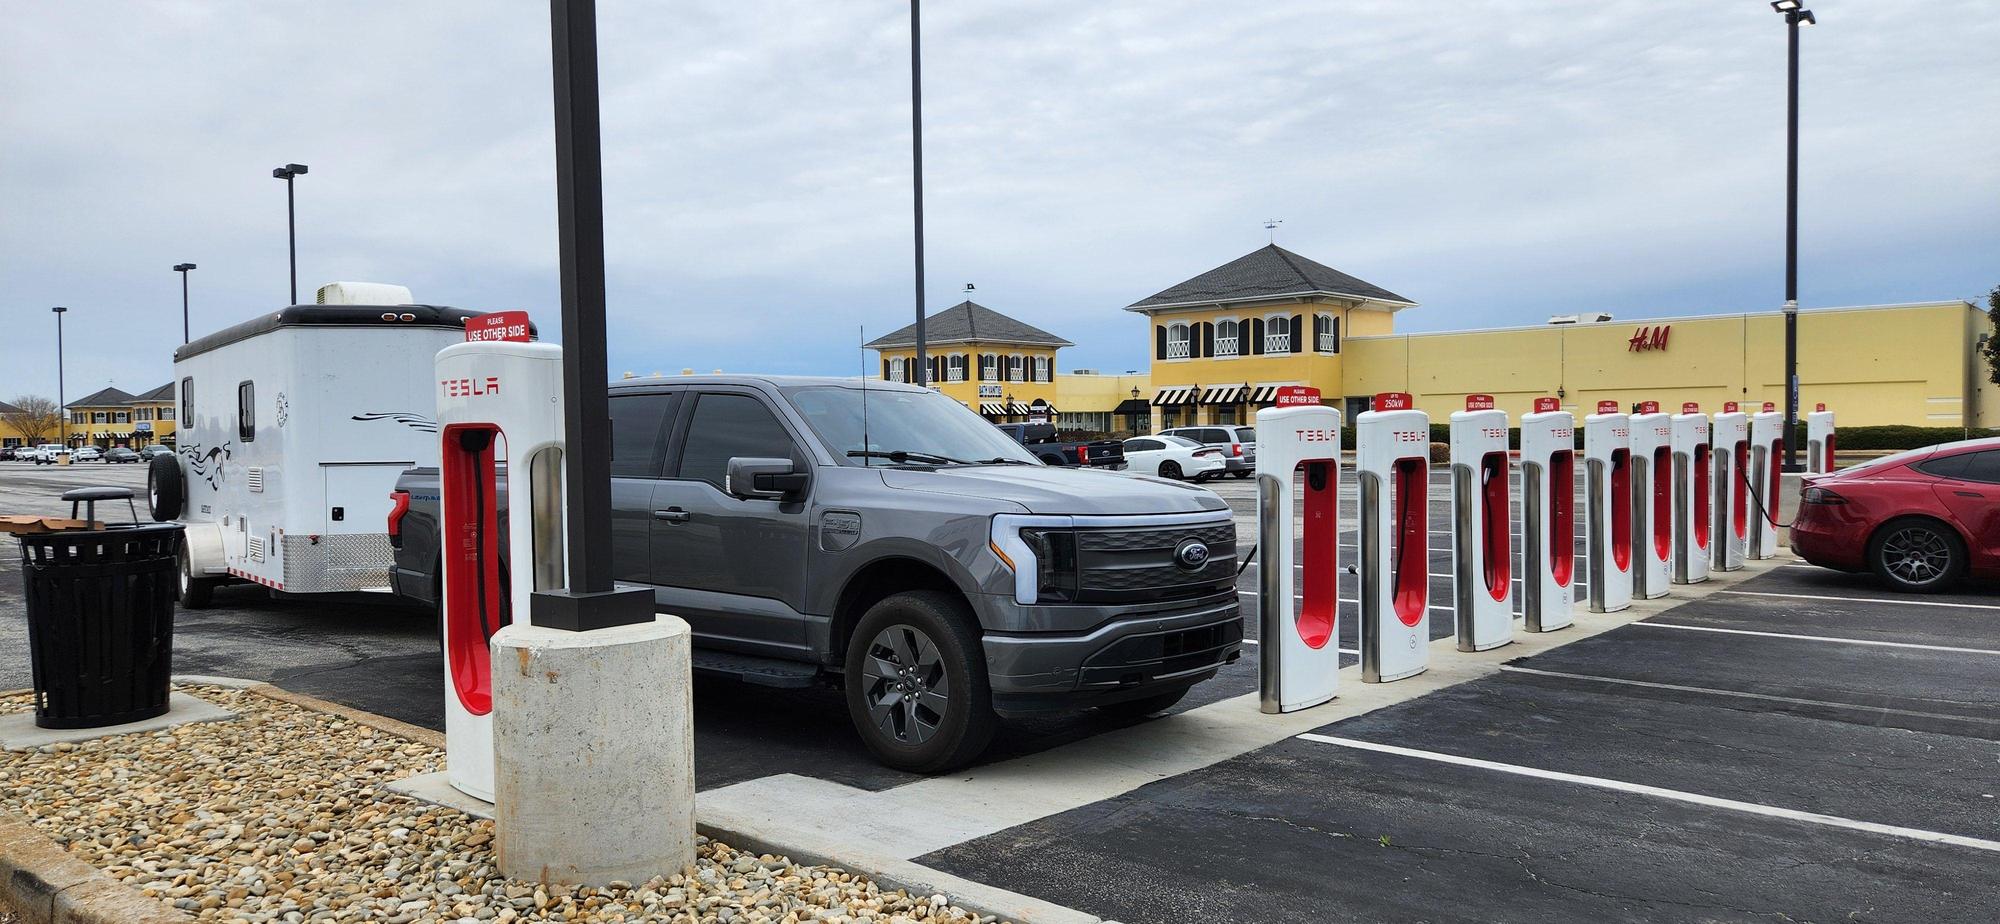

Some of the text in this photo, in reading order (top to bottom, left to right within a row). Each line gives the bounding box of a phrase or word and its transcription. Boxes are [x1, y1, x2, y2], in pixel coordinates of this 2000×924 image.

[487, 316, 504, 326] PLEASE
[468, 324, 525, 341] USE OTHER SIDE
[1628, 325, 1670, 353] H&M
[441, 377, 498, 398] TESLA
[1279, 395, 1320, 404] USE OTHER SIDE
[1384, 399, 1404, 408] 250kW
[1296, 429, 1335, 442] TESLA
[1393, 431, 1426, 442] TESLA
